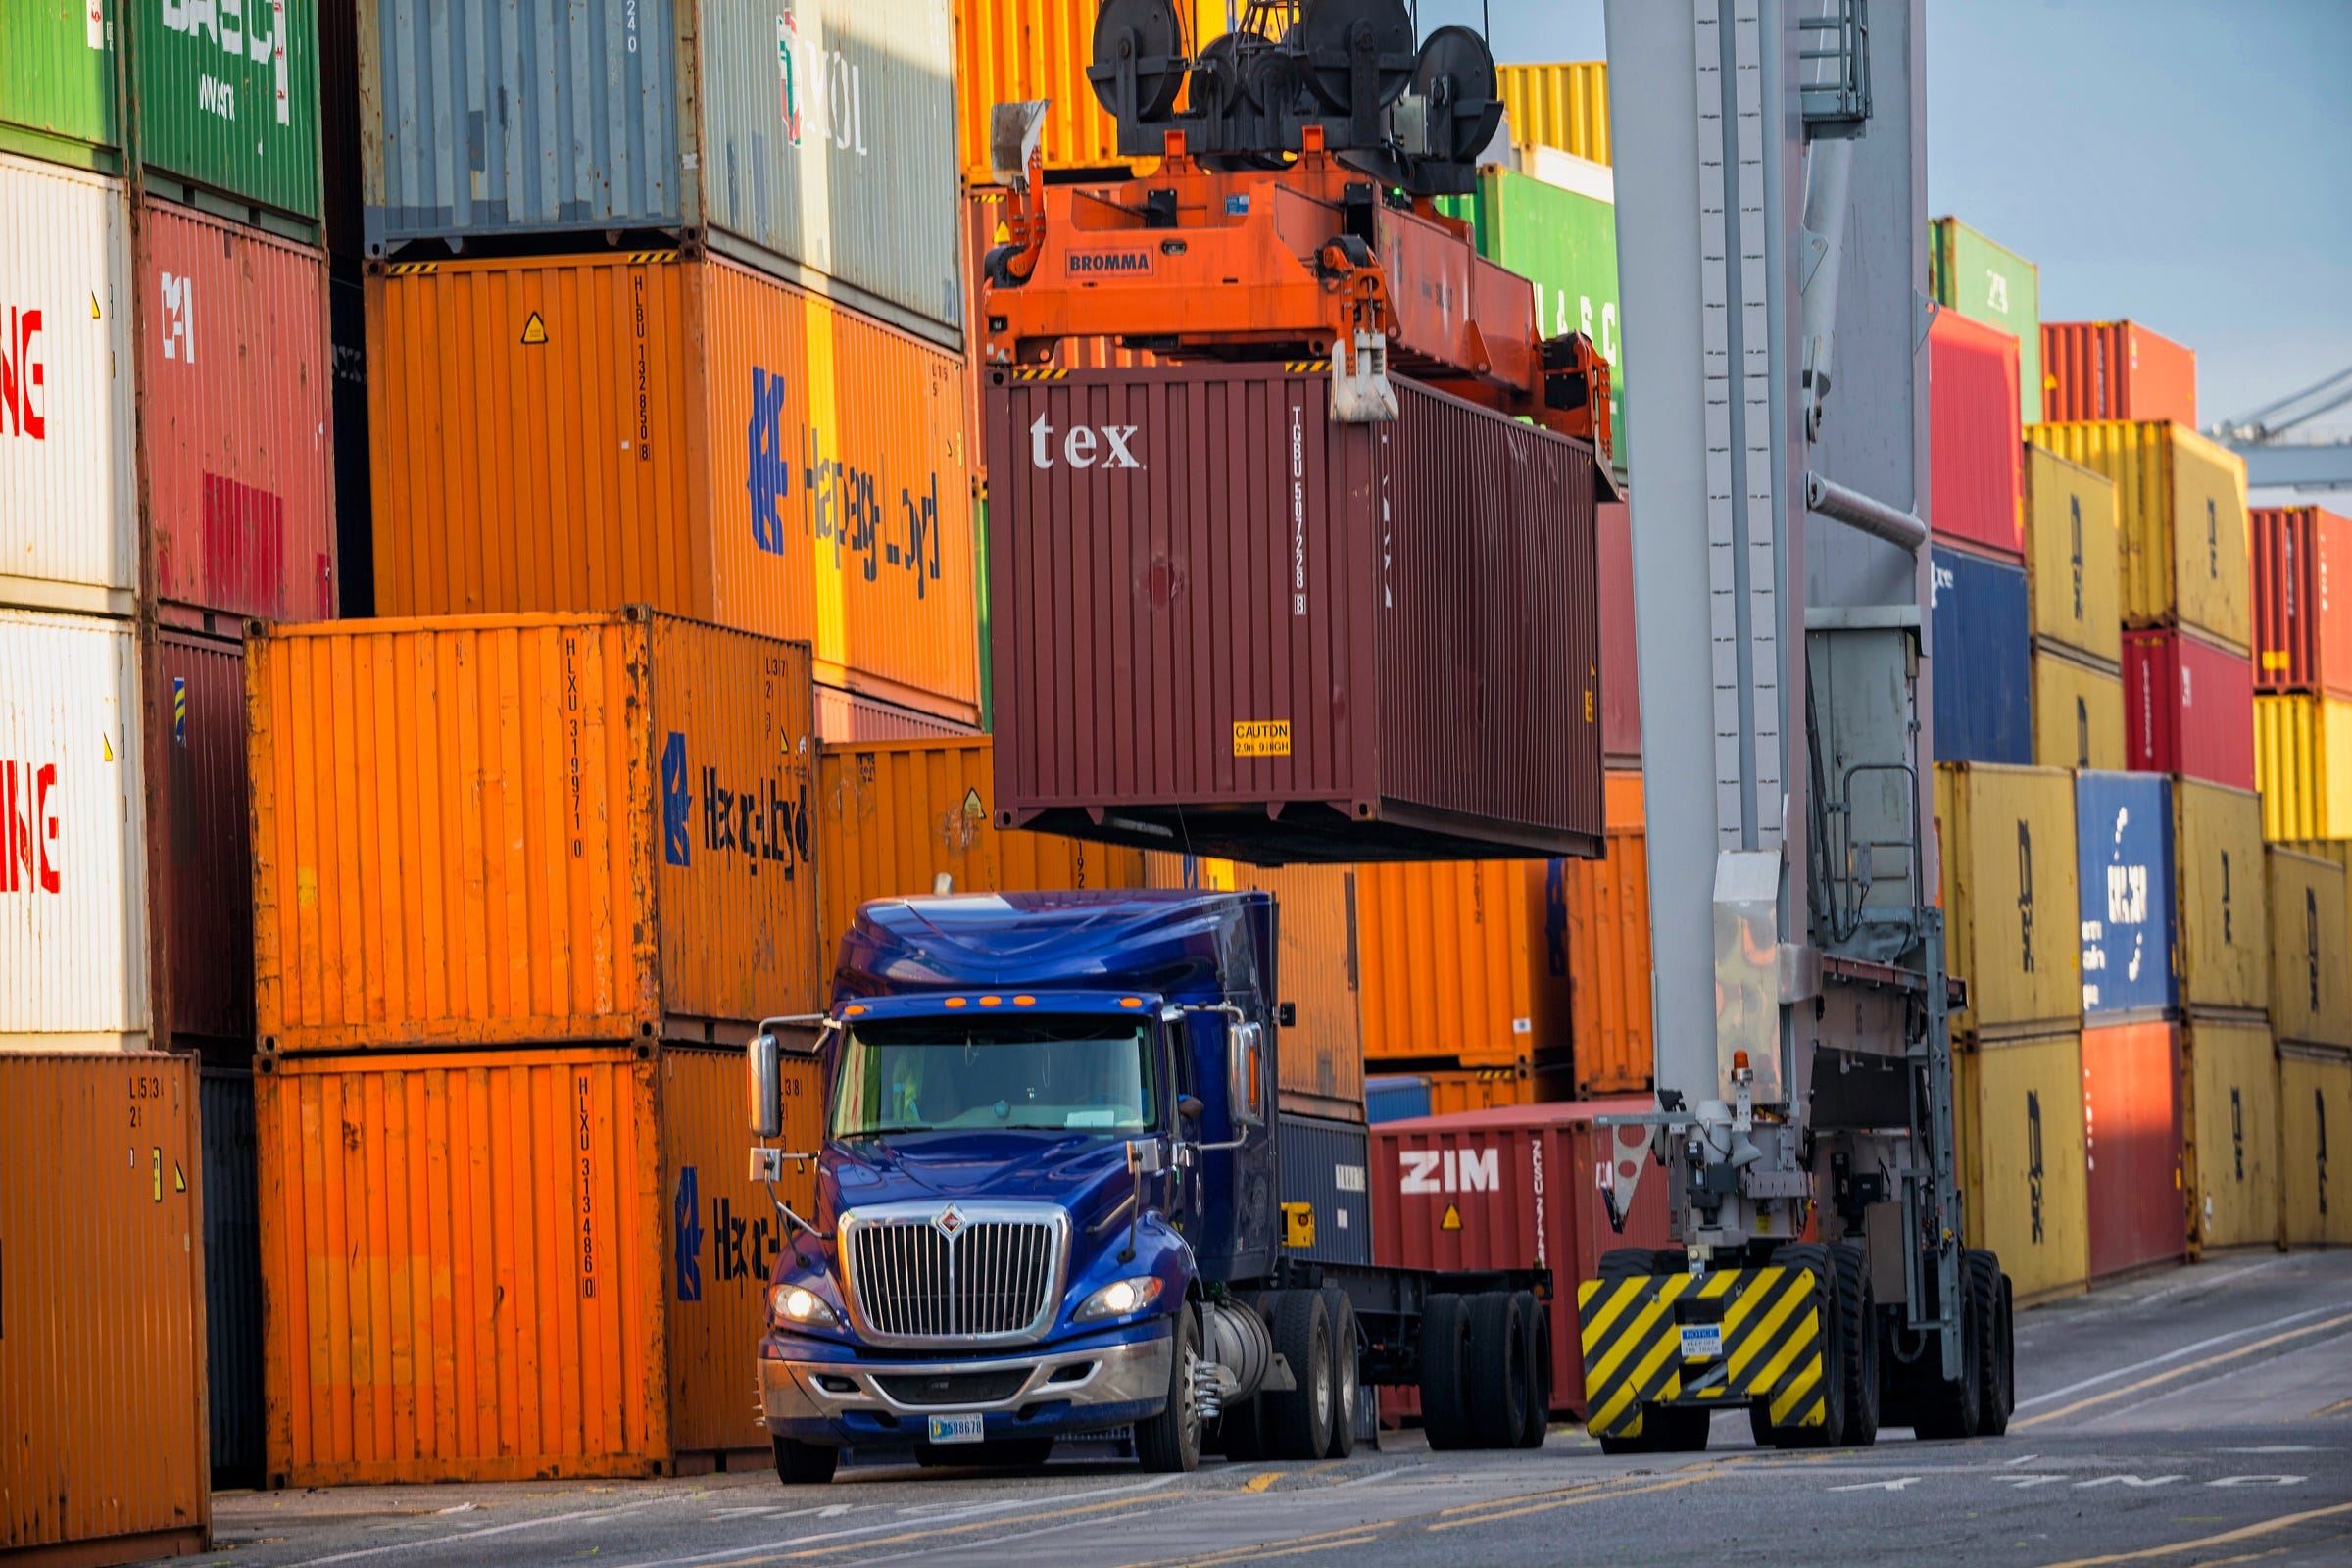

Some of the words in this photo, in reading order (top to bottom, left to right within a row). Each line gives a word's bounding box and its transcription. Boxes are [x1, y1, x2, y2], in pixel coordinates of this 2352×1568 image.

[1070, 254, 1149, 271] BROMMA
[635, 275, 645, 338] HLBU
[638, 344, 648, 440] 132850
[1030, 411, 1140, 469] tex
[1293, 406, 1302, 478] TGBU
[801, 423, 941, 600] Hapag-Loyd
[1295, 481, 1304, 588] 507228
[566, 638, 577, 711] HLXU
[570, 719, 581, 830] 319971
[703, 765, 809, 881] Hapg-Lloyd
[578, 1077, 589, 1151] HLXU
[1399, 1148, 1500, 1195] ZIM
[581, 1158, 593, 1273] 313486
